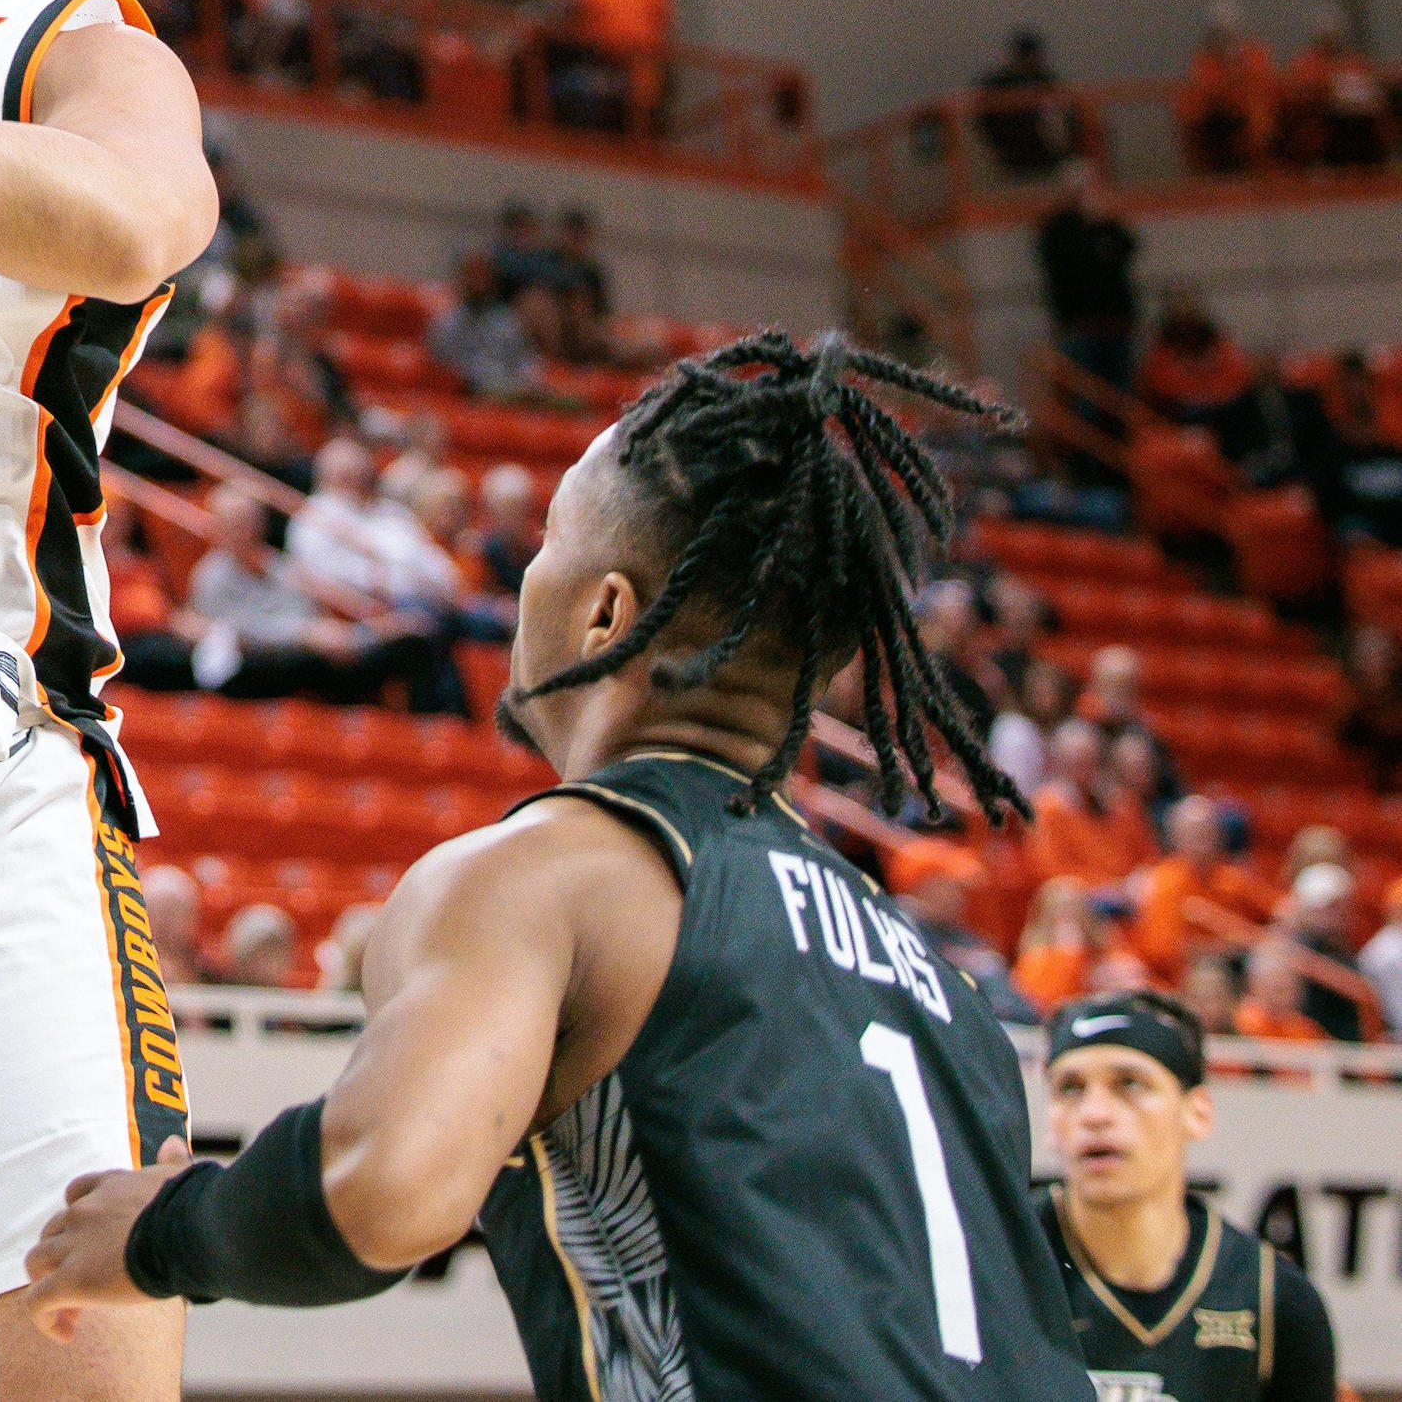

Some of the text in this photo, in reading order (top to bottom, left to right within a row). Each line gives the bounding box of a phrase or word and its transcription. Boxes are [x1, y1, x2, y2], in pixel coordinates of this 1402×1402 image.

[98, 822, 188, 1113] COWBOYS
[768, 850, 952, 1023] FULKS
[859, 1021, 982, 1366] 1
